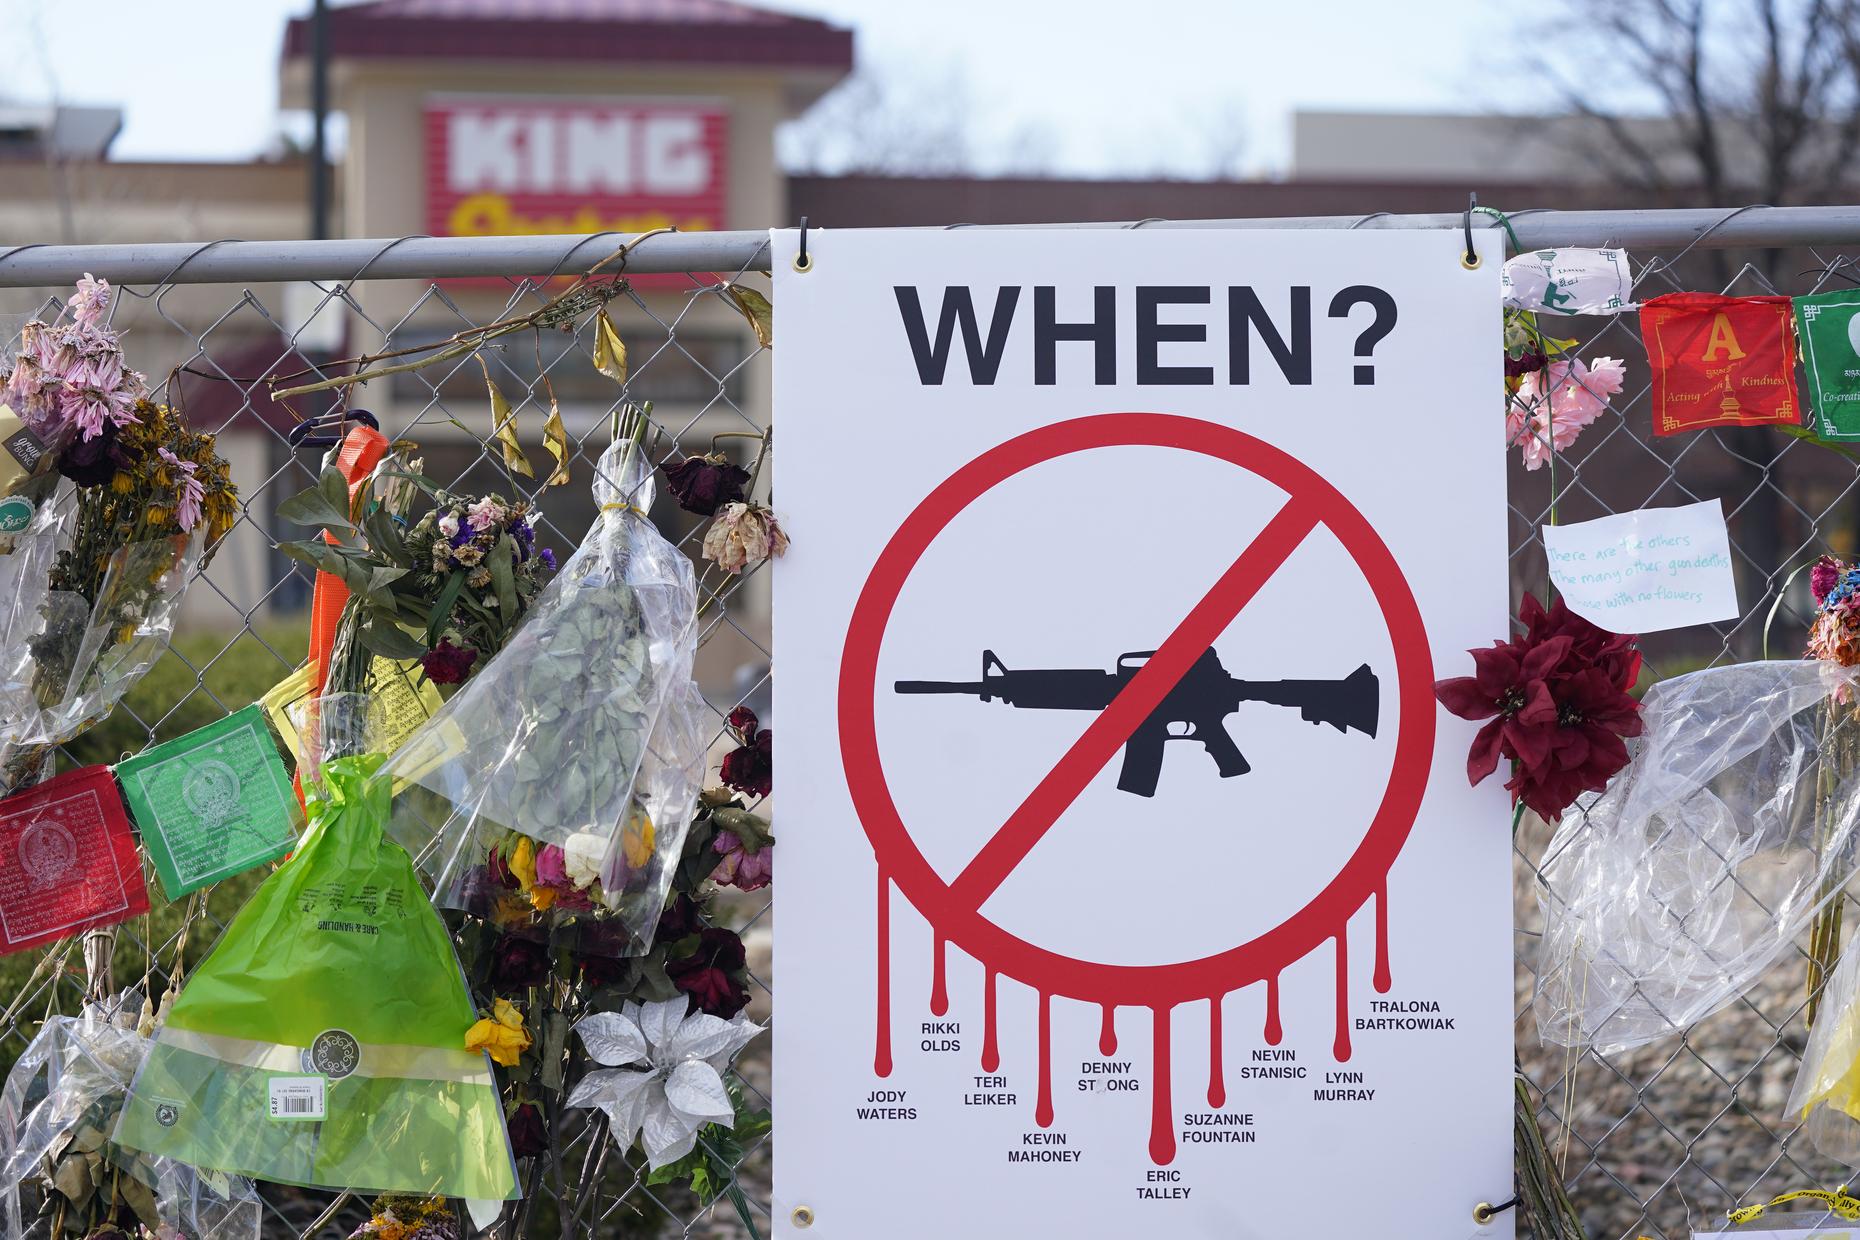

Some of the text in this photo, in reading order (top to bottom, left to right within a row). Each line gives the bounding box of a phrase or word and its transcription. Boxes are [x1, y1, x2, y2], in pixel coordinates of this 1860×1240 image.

[450, 114, 711, 195] KING
[893, 285, 1397, 385] WHEN?
[1701, 312, 1746, 361] A
[1667, 391, 1701, 405] Acting
[1741, 374, 1786, 387] Kindness
[1548, 547, 1586, 561] There
[1596, 548, 1616, 560] are
[1649, 534, 1691, 549] others
[1551, 570, 1577, 584] The
[1582, 571, 1621, 583] many
[1625, 559, 1661, 576] other
[1606, 591, 1633, 608] with
[1638, 592, 1652, 602] no
[1653, 585, 1703, 603] flowers
[318, 921, 379, 935] CARE & HANDLING
[1370, 1001, 1440, 1012] TRALONA
[922, 1023, 959, 1034] RIKKI
[1356, 1018, 1455, 1030] BARTKOWIAK
[921, 1040, 960, 1051] OLDS
[1252, 1050, 1295, 1061] NEVIN
[1082, 1062, 1131, 1073] DENNY
[1241, 1067, 1306, 1078] STANISIC
[974, 1076, 1007, 1088] TERI
[1326, 1072, 1363, 1083] LYNN
[1078, 1079, 1139, 1091] STONG
[867, 1091, 906, 1102] JODY
[965, 1094, 1016, 1105] LEIKER
[1314, 1090, 1375, 1101] MURRAY
[857, 1108, 917, 1119] WATERS
[1184, 1114, 1253, 1125] SUZANNE
[1023, 1134, 1066, 1144] KEVIN
[1183, 1131, 1255, 1143] FOUNTAIN
[1009, 1151, 1081, 1162] MAHONEY
[1147, 1170, 1180, 1182] ERIC
[1136, 1188, 1191, 1199] TALLEY
